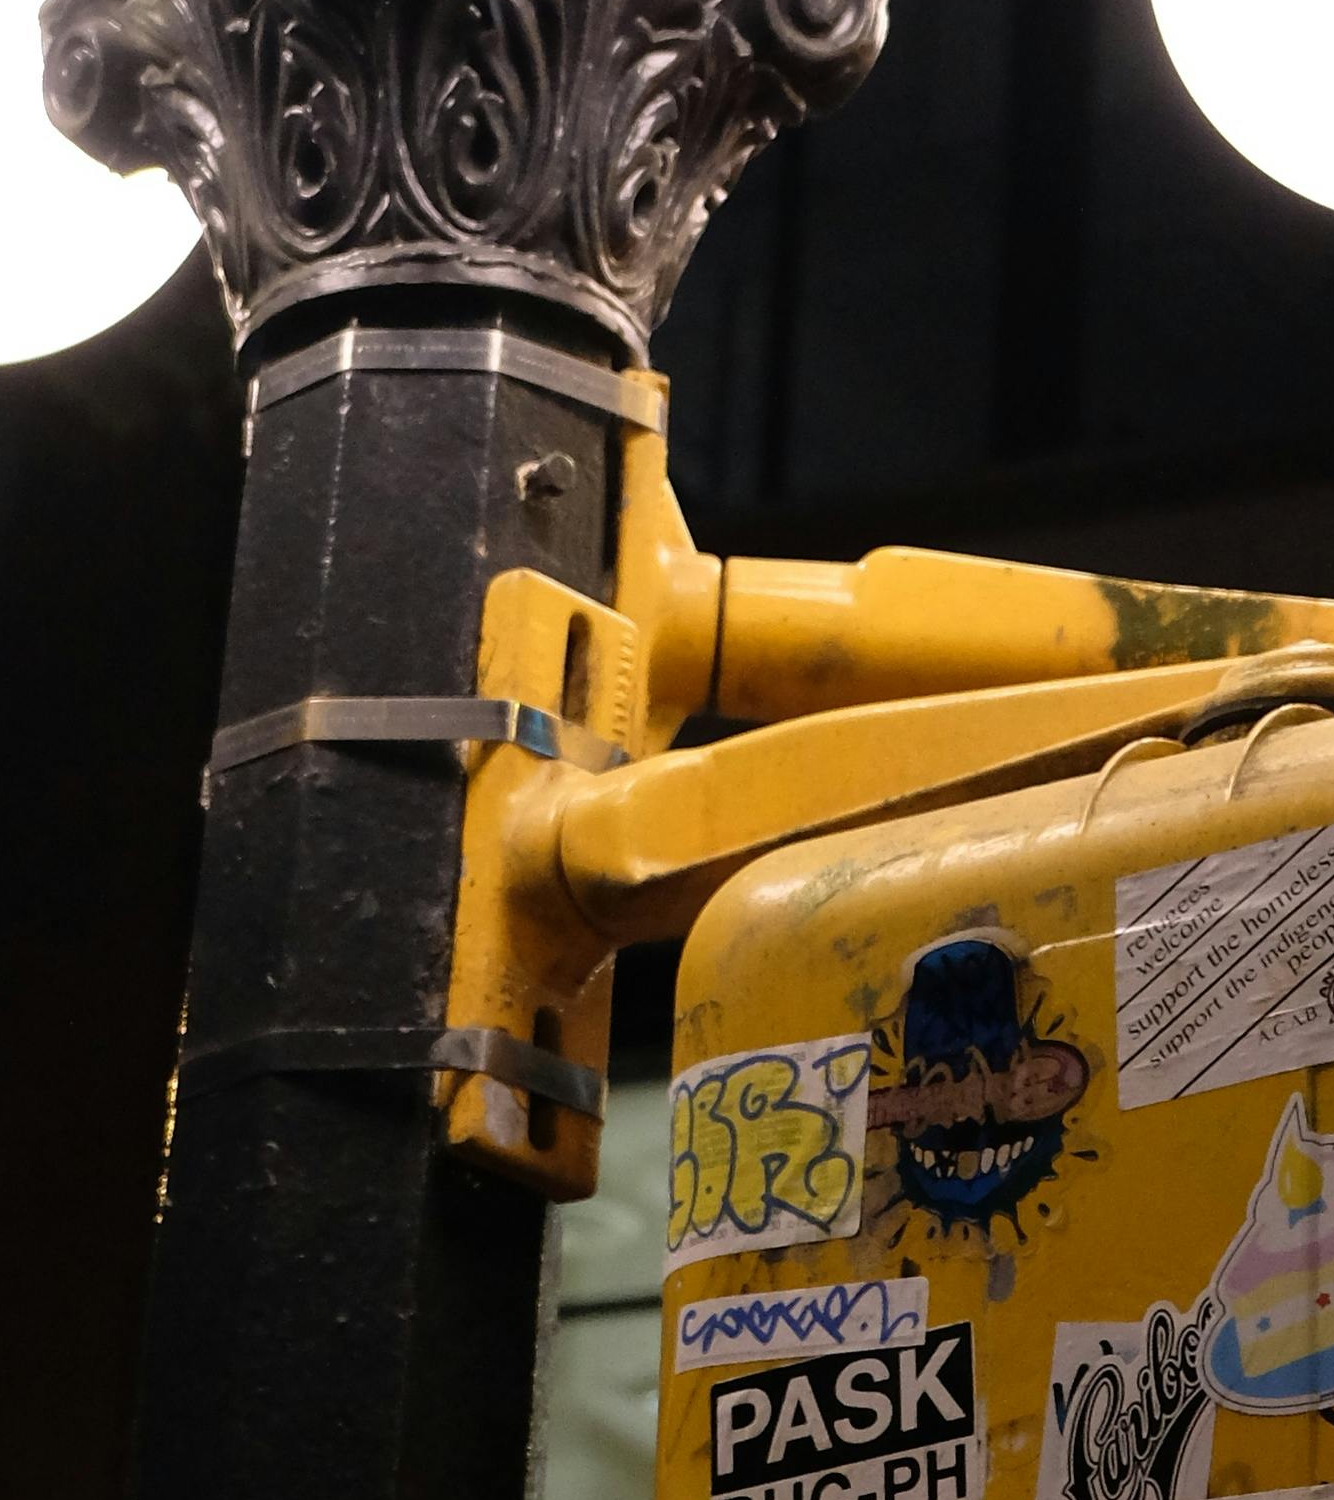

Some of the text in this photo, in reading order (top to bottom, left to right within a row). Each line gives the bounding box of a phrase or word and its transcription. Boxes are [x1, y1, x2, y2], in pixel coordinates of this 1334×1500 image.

[1126, 884, 1211, 958] refugees
[1135, 897, 1224, 975] welcome
[1127, 965, 1206, 1041] support
[1207, 934, 1241, 968] the
[1150, 997, 1224, 1069] support
[1225, 967, 1258, 999] the
[716, 1337, 967, 1477] PASK
